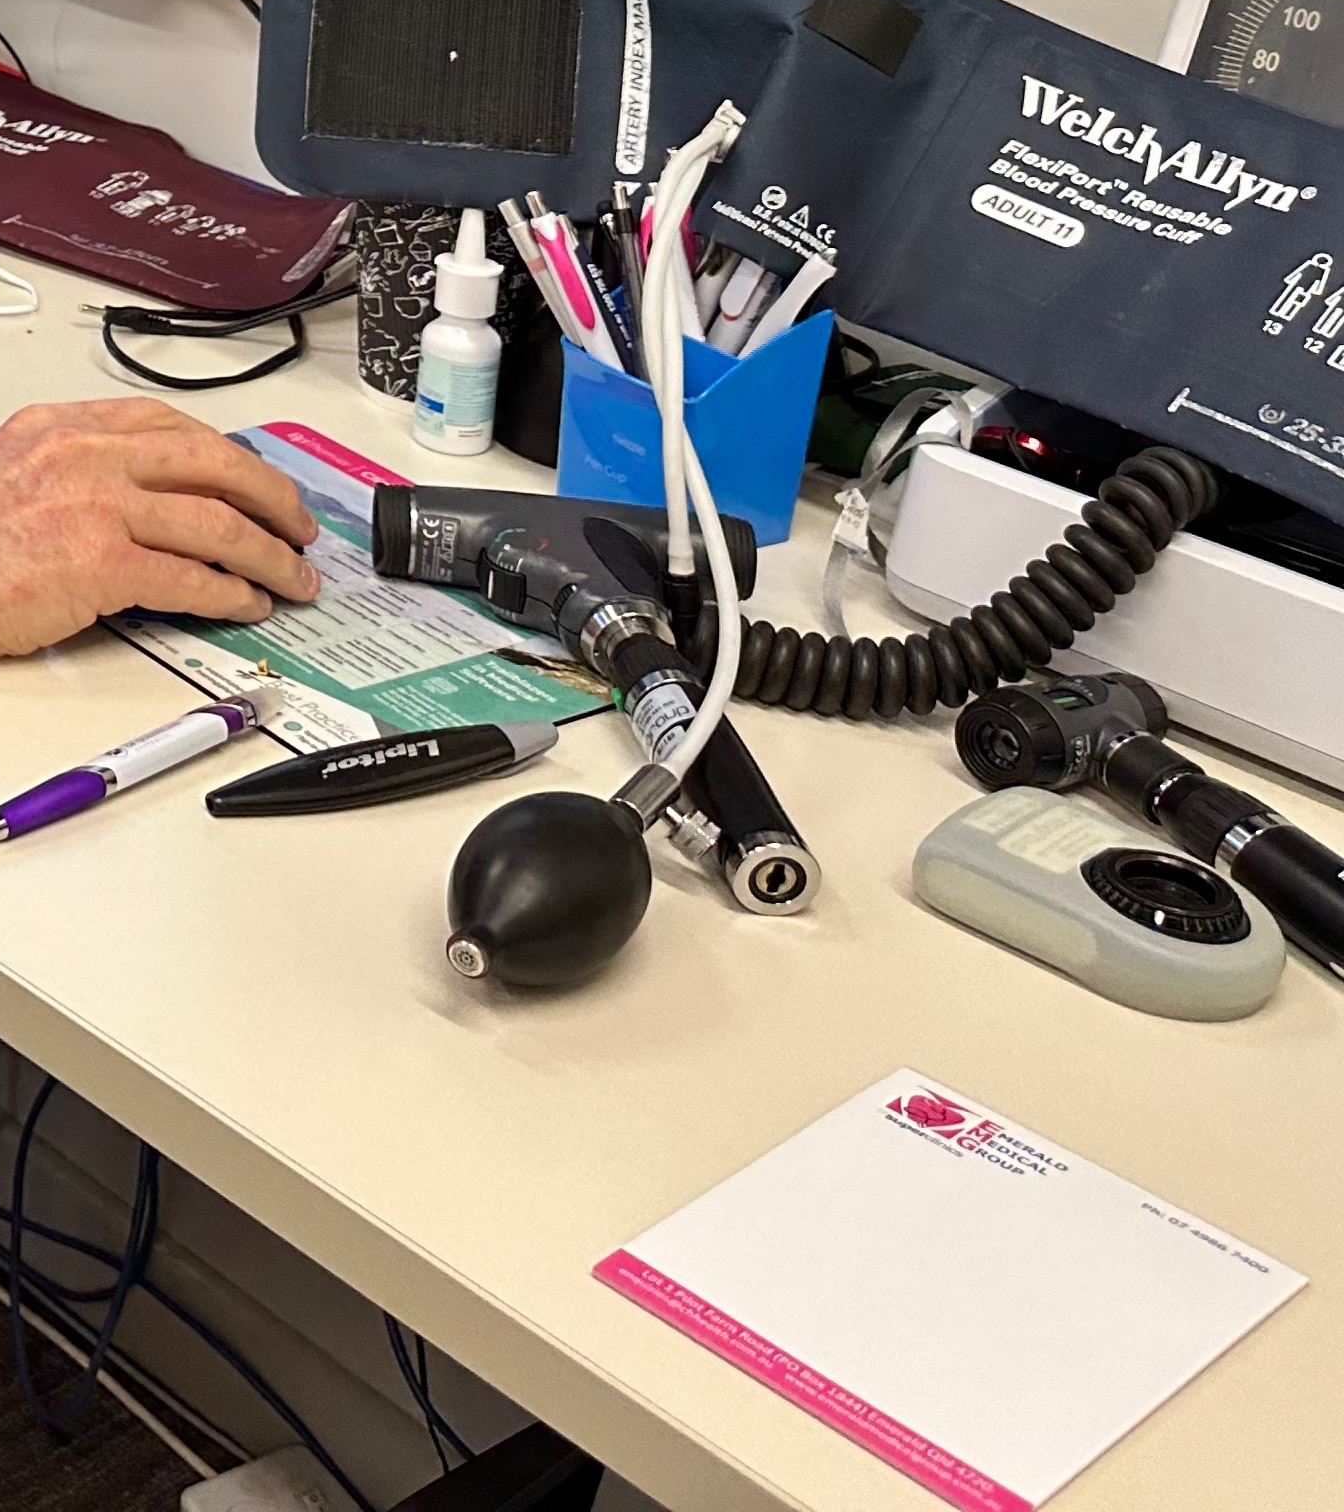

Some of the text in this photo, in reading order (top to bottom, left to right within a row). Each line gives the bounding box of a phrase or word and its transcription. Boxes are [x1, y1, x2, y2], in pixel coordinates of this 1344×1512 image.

[1283, 6, 1320, 31] 100
[630, 38, 645, 91] INDEX
[1252, 49, 1280, 71] 80
[623, 96, 642, 165] ARTERY
[983, 194, 1075, 241] ADULT 11
[989, 159, 1204, 245] Blood Pressure Cuff
[1121, 191, 1233, 236] Reusable
[1262, 319, 1283, 335] 13
[1303, 338, 1325, 354] 12
[604, 465, 627, 484] Cup
[265, 680, 298, 706] Best
[301, 702, 360, 741] Practice
[321, 739, 441, 779] Lipitor
[885, 1114, 963, 1157] superclinics
[957, 1136, 1025, 1175] GROUP
[966, 1127, 1048, 1176] MEDICAL
[979, 1120, 1069, 1172] EMERALD
[1168, 1217, 1189, 1228] 07
[1231, 1250, 1269, 1273] 7400
[642, 1270, 663, 1286] Lot
[674, 1289, 705, 1311] Pilot
[705, 1309, 738, 1333] Farm
[739, 1331, 775, 1355] Road
[867, 1412, 928, 1450] Emerald
[927, 1448, 954, 1468] Qld
